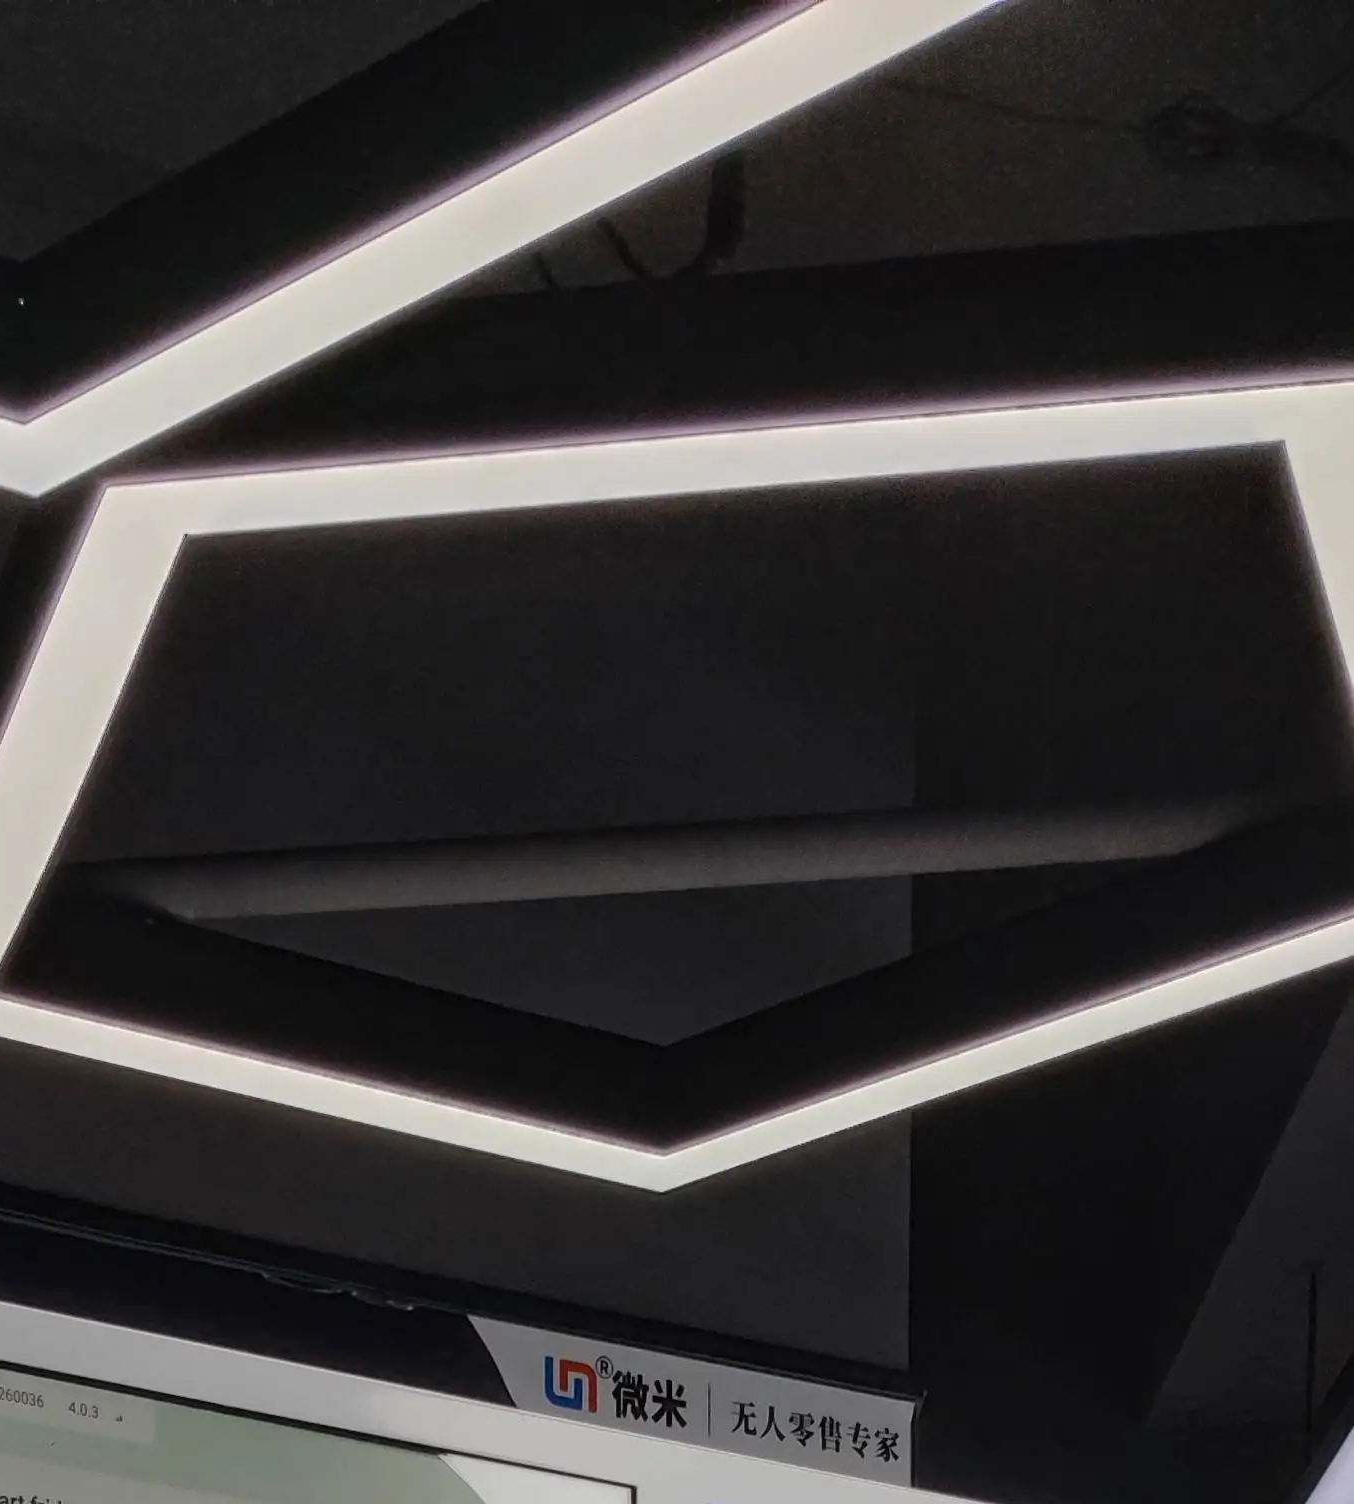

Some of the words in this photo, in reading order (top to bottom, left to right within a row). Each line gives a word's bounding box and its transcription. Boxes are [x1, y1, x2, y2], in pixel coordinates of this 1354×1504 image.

[68, 1401, 99, 1420] 4.0.3
[611, 1370, 687, 1428] 微米
[730, 1401, 900, 1463] 无人零售专家
